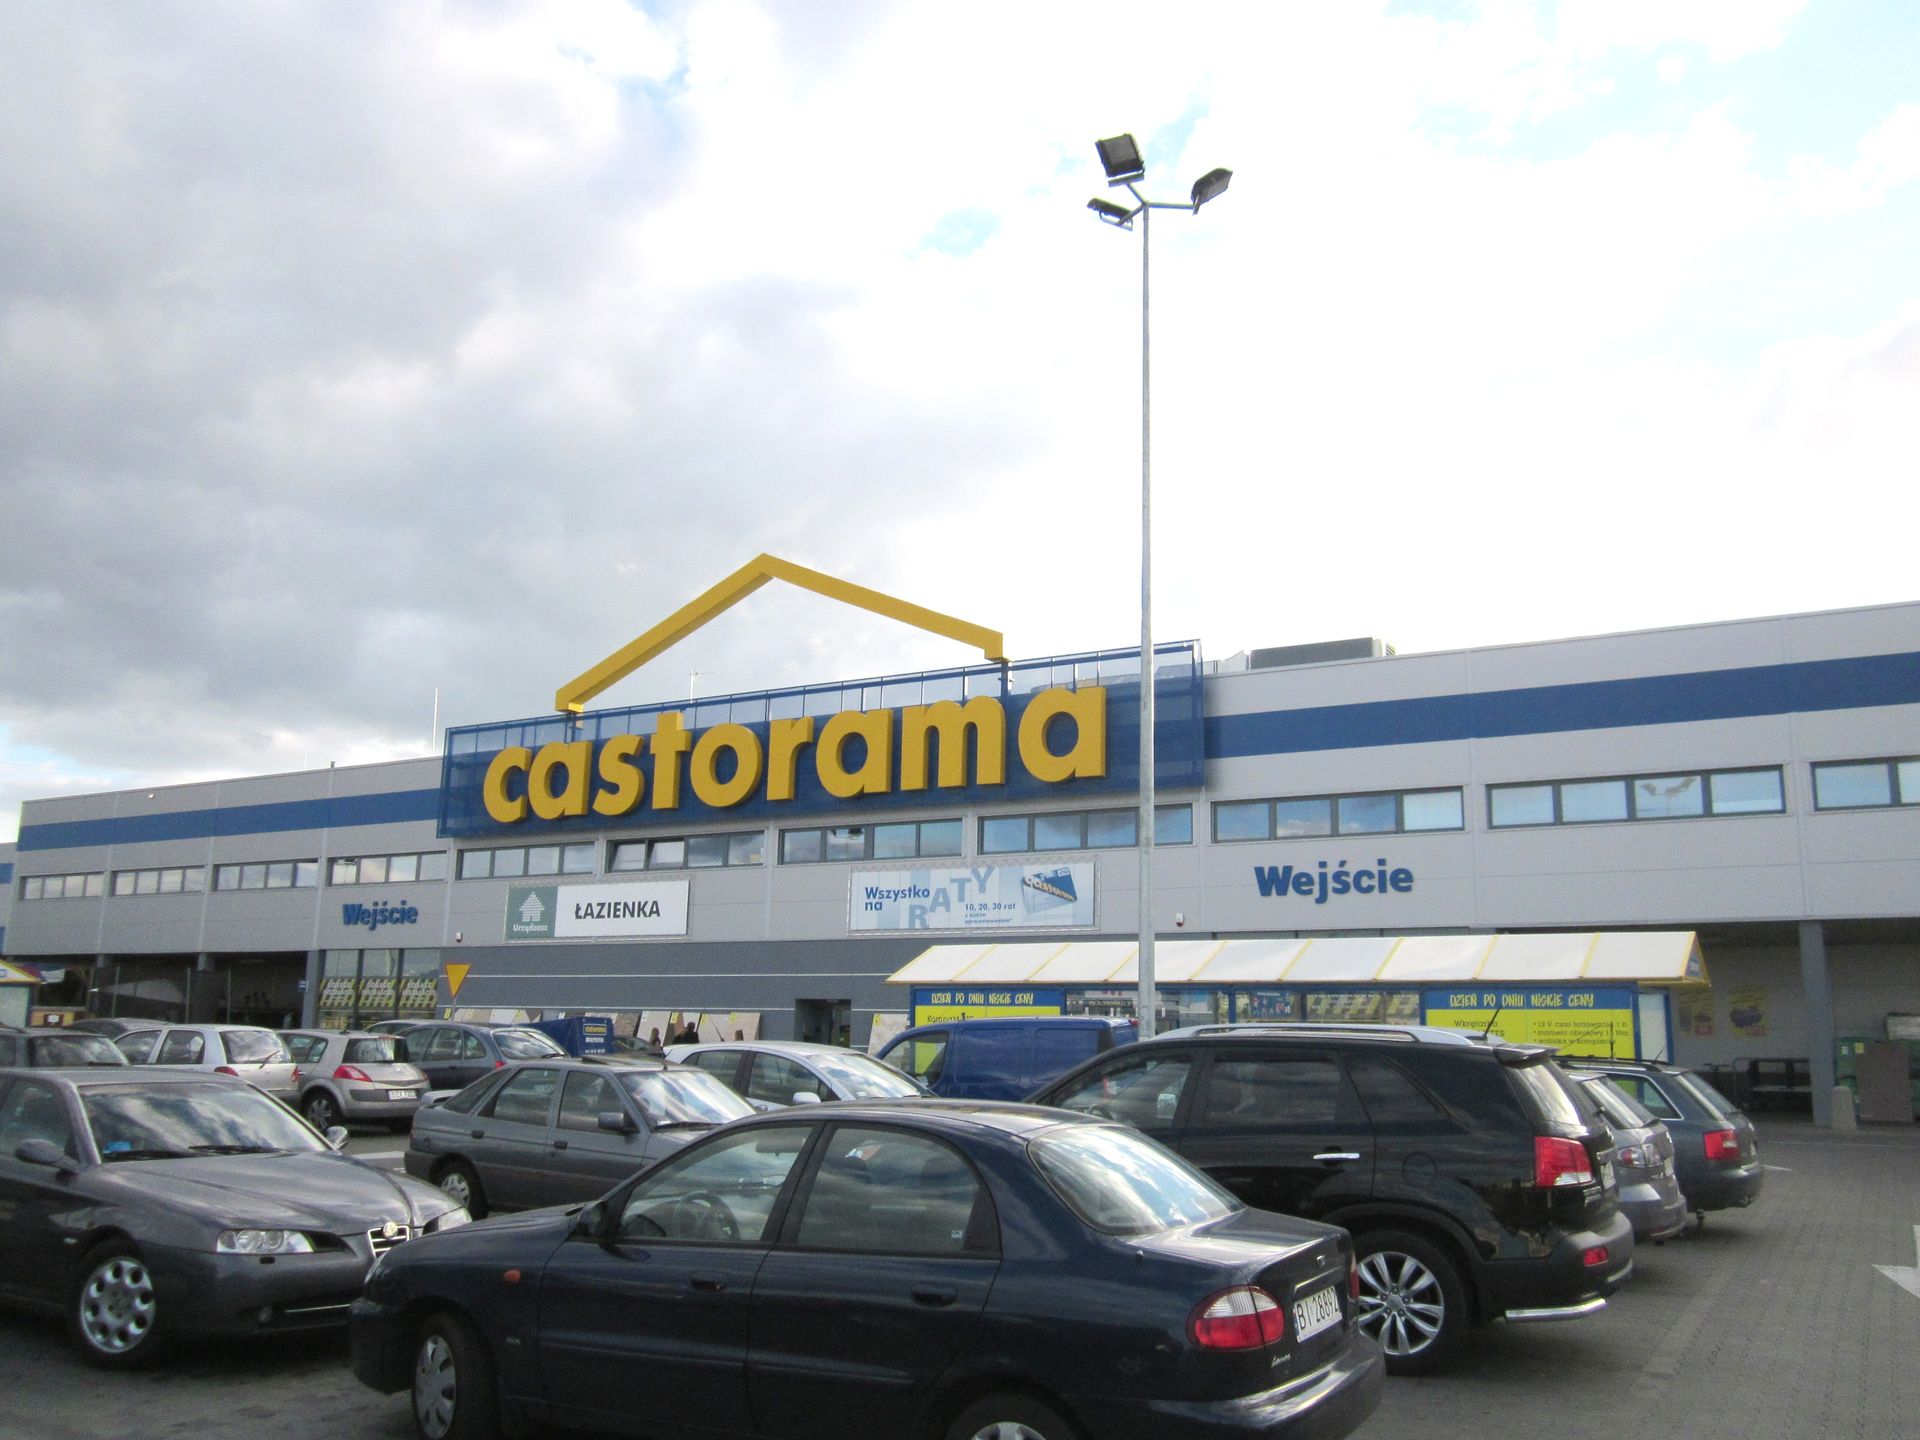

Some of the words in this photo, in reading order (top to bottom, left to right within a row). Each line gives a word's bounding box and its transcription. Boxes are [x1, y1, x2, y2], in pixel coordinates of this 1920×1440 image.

[482, 686, 1107, 823] castorama
[1253, 858, 1414, 905] Wejście
[864, 884, 930, 902] Wszystko
[342, 900, 418, 931] Wejście
[575, 900, 661, 920] ŁAZIENKA
[864, 901, 883, 911] na
[992, 902, 1002, 910] 30
[955, 992, 965, 1003] PO
[989, 992, 1012, 1005] NISKIE
[1015, 992, 1034, 1005] CENY
[1450, 993, 1478, 1007] DZIEŃ
[1483, 993, 1496, 1007] PO
[1531, 993, 1563, 1007] NISKIE
[1568, 993, 1594, 1007] CENY
[1296, 1301, 1312, 1331] BI
